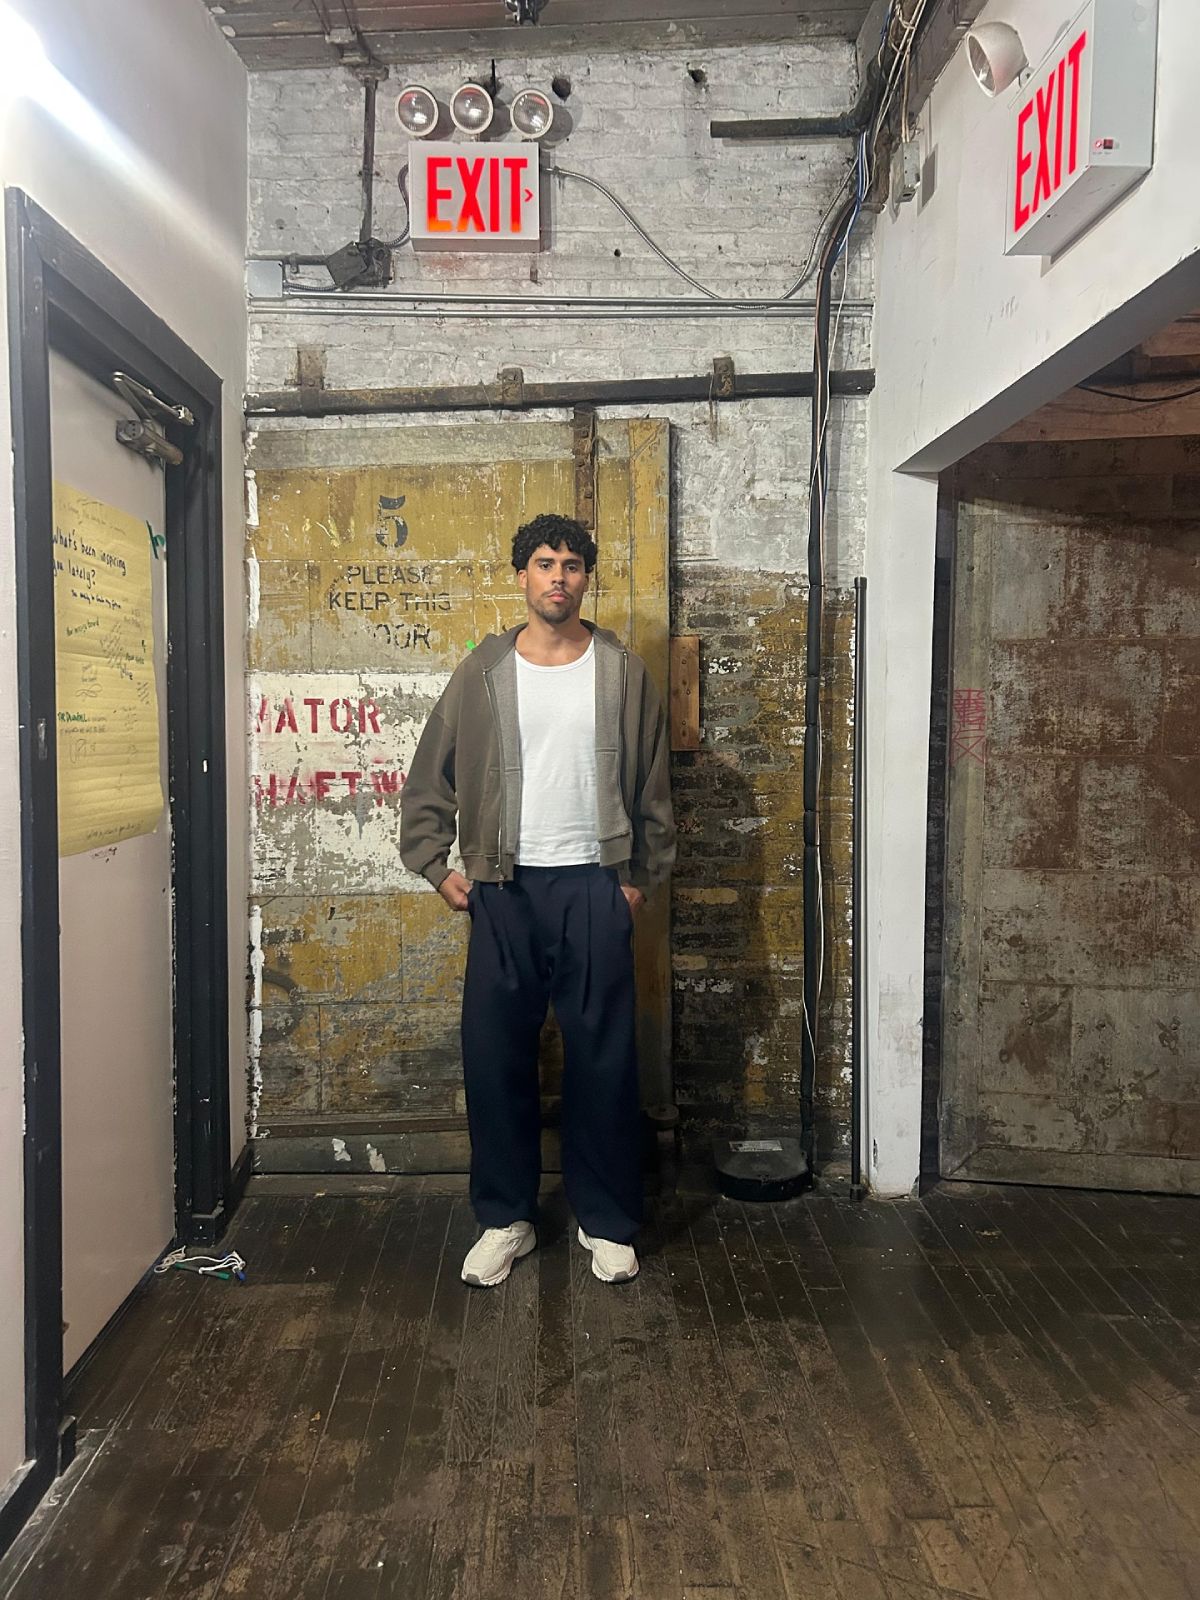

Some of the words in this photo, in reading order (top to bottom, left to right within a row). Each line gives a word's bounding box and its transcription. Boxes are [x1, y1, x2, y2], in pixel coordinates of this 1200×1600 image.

[1014, 31, 1087, 233] EXIT
[426, 156, 528, 232] EXIT
[375, 494, 408, 548] 5
[347, 565, 435, 585] PLEASE
[329, 591, 391, 611] KEEP
[399, 591, 451, 611] THIS
[367, 623, 431, 649] OOR
